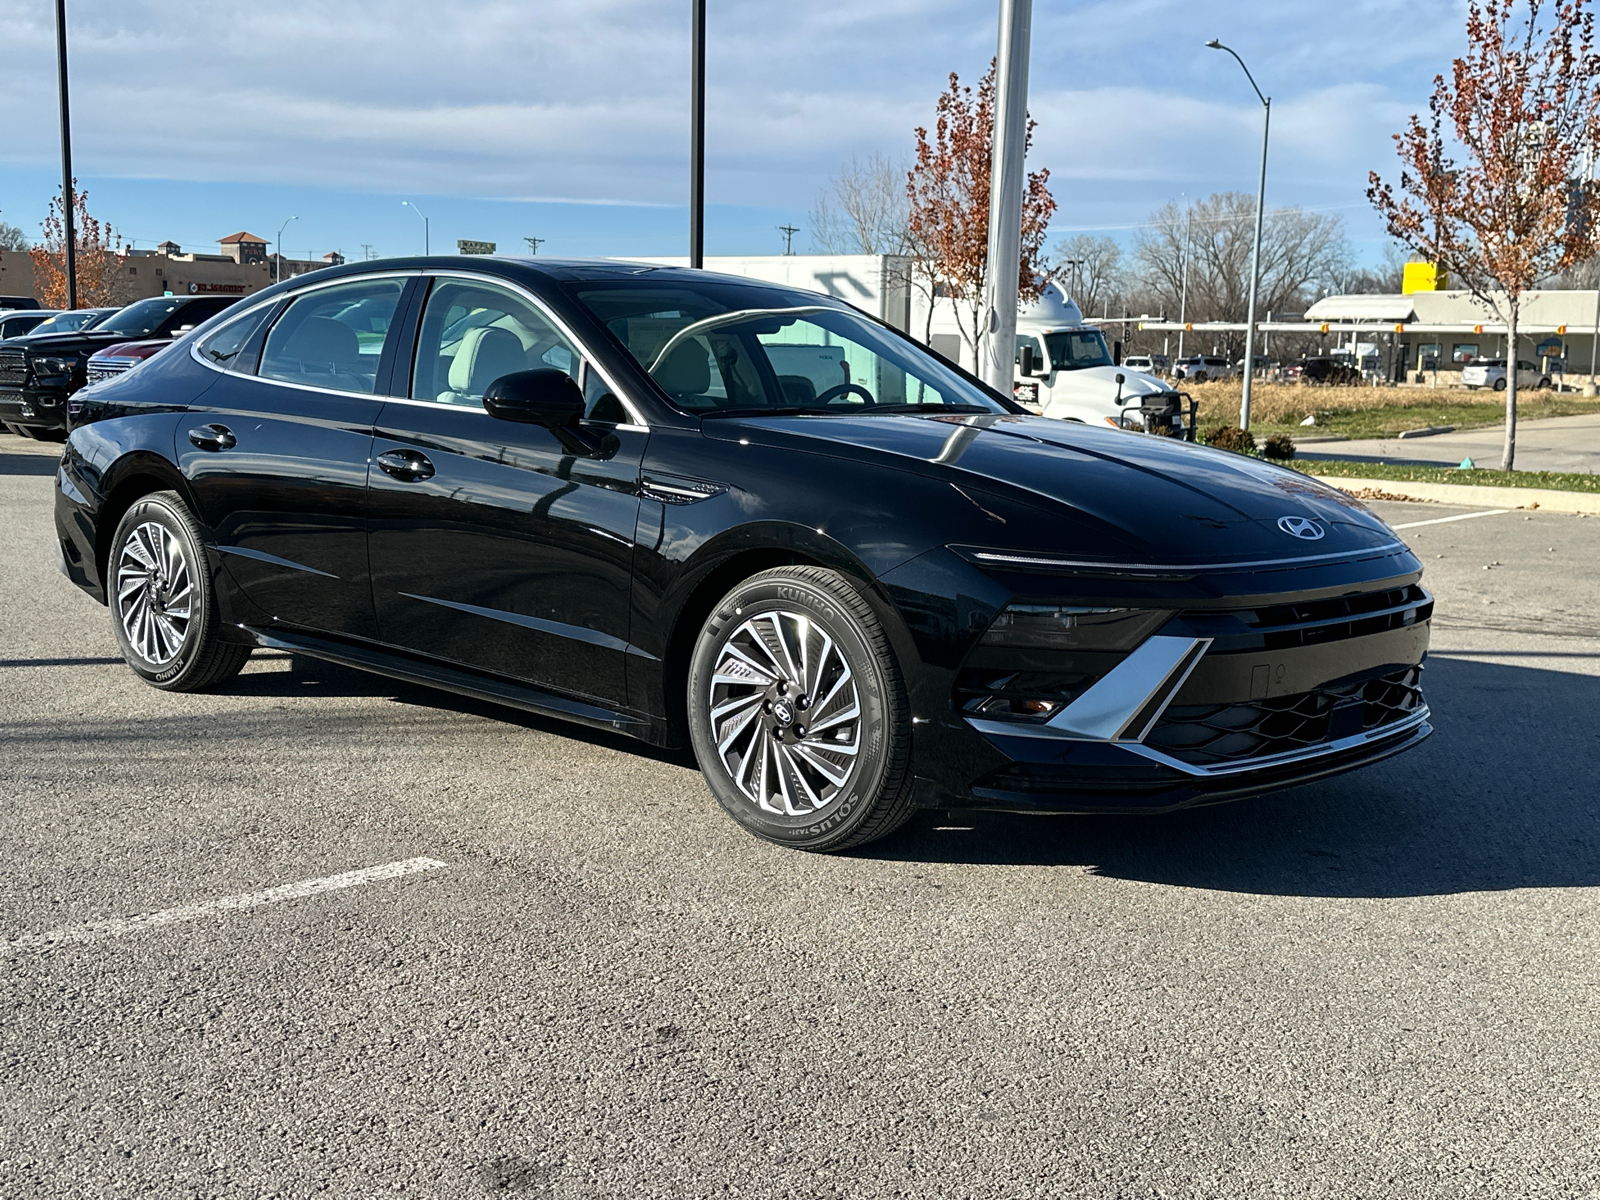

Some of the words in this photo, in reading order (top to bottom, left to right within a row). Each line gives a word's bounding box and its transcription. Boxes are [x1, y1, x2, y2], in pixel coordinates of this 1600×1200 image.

[777, 587, 835, 621] KUMHO
[155, 658, 184, 681] KUMHO
[810, 793, 859, 836] SOLUS
